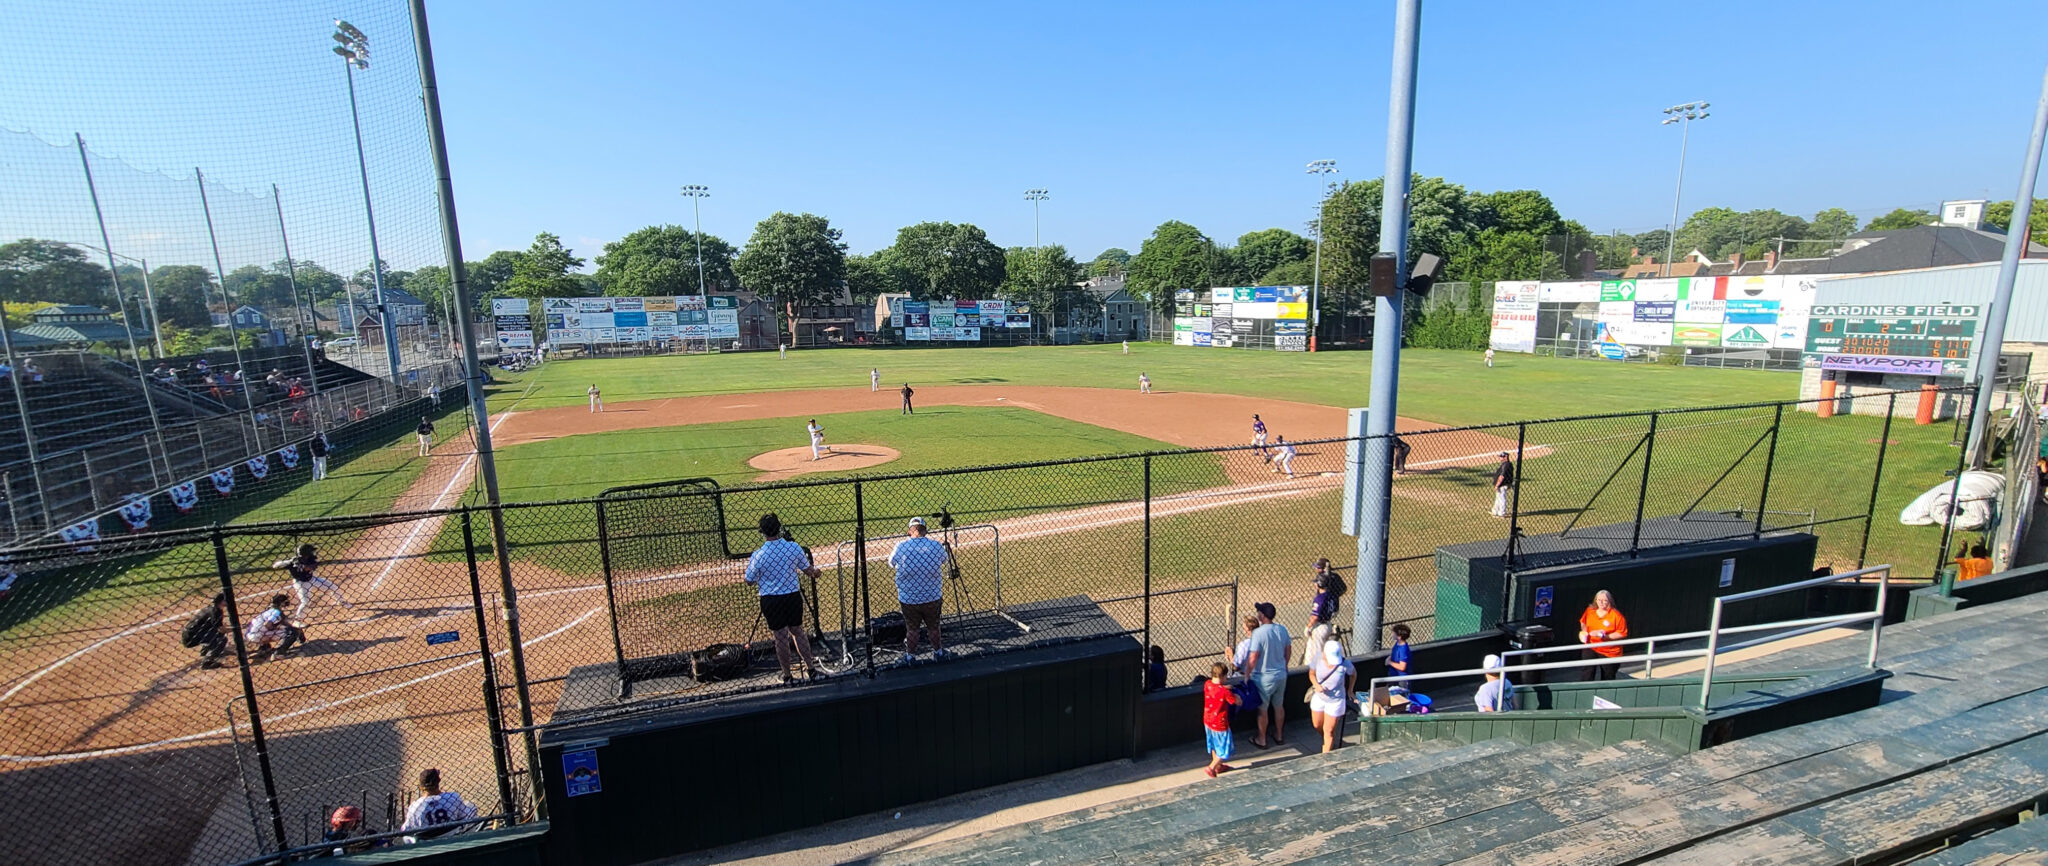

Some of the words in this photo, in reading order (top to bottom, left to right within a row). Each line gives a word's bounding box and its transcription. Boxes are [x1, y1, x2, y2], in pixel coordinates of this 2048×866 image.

[1813, 306, 1907, 316] CARDINES
[1913, 306, 1975, 317] FIELD
[1881, 323, 1890, 334] 2
[1825, 356, 1941, 368] NEWPORT
[425, 809, 449, 826] 18
